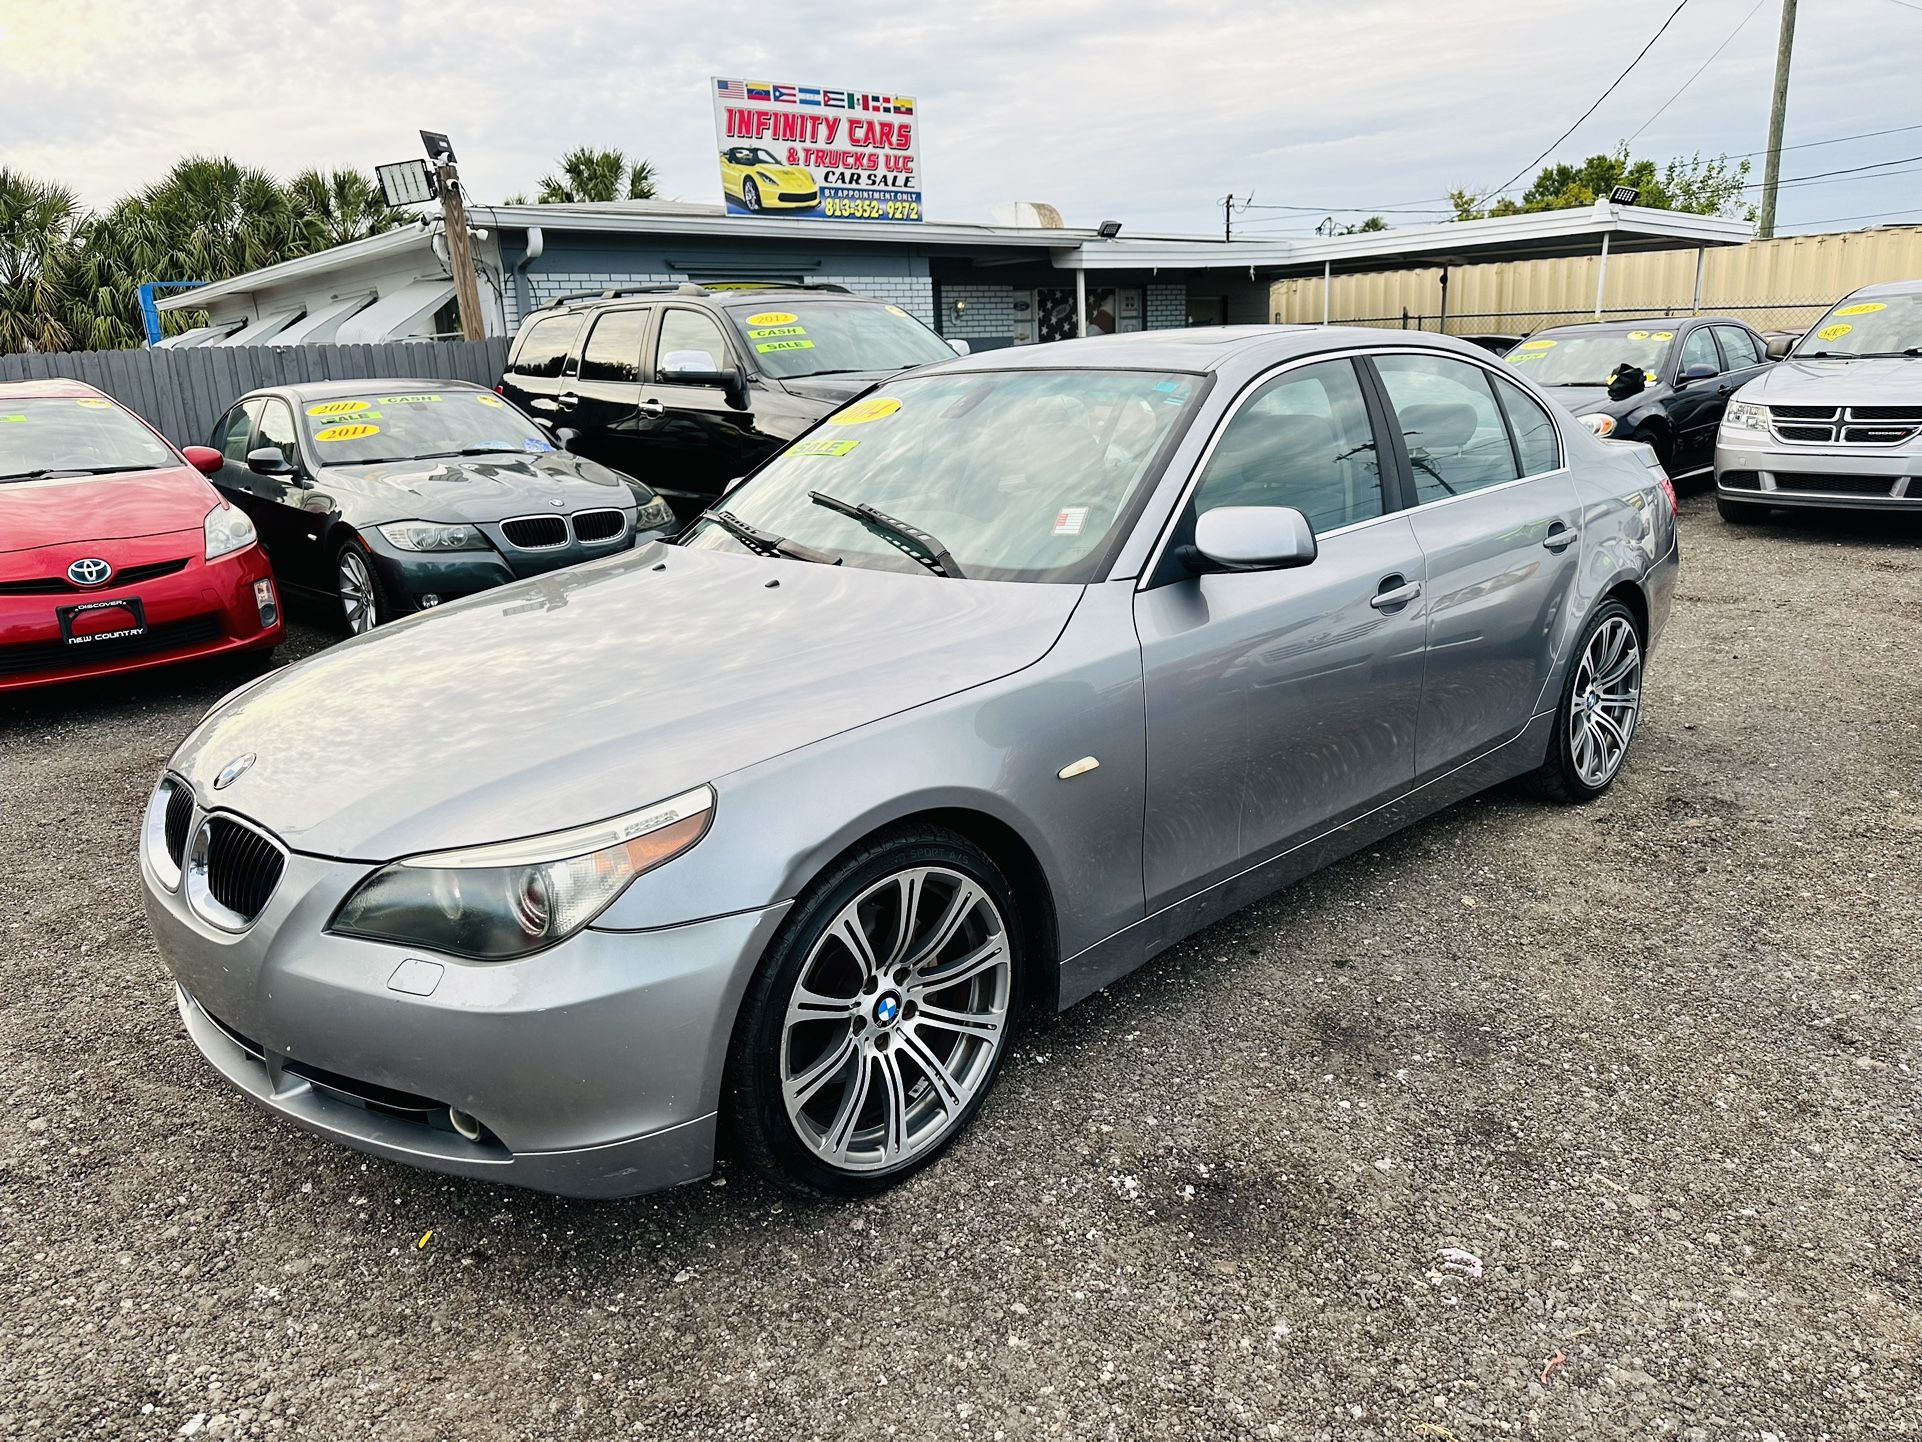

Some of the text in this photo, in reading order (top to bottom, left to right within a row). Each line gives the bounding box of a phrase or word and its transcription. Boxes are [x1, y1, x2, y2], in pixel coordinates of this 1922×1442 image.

[725, 107, 911, 149] INFINITY CARS
[787, 147, 799, 165] &
[802, 148, 879, 171] TRUCKS
[824, 170, 915, 188] CAR SALE
[824, 188, 917, 201] BY APPOINTMENT ONLY
[758, 314, 790, 324] 2012
[757, 328, 797, 337] CASH
[766, 342, 803, 350] SALE
[318, 402, 357, 414] 2011
[327, 426, 369, 439] 2011
[78, 600, 122, 610] DISCOVER
[68, 628, 144, 645] NEW COUNTRY
